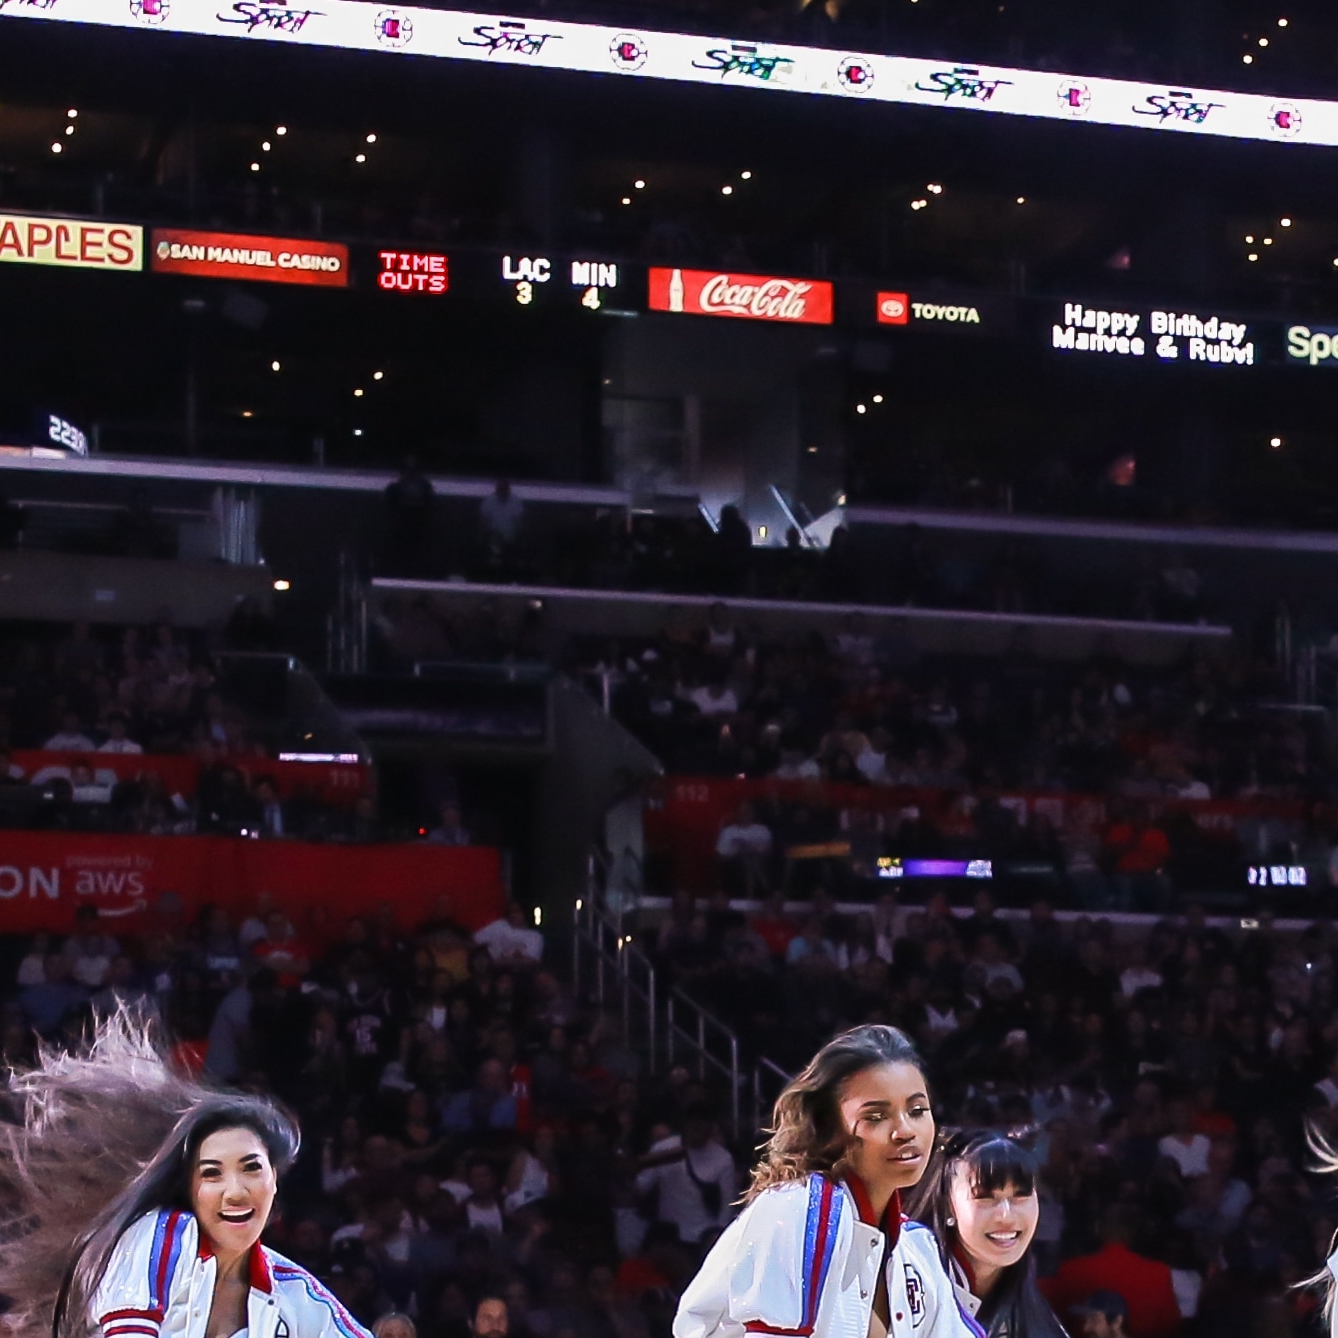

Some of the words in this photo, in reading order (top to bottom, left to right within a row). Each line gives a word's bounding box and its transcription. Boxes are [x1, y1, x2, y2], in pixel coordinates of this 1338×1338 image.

[170, 243, 206, 261] SAN
[208, 246, 276, 268] MANUEL
[278, 252, 341, 272] CASINO
[379, 251, 447, 273] TIME
[502, 256, 551, 282] LAC
[571, 261, 618, 288] MIN
[380, 272, 447, 292] OUTS
[516, 281, 533, 305] 3
[582, 287, 601, 310] 4
[911, 302, 980, 324] TOYOTA
[1064, 303, 1140, 336] Happy
[1151, 311, 1247, 345] Birthday
[1156, 335, 1178, 358] &
[1189, 338, 1254, 365] Ruby!
[76, 870, 145, 896] aws
